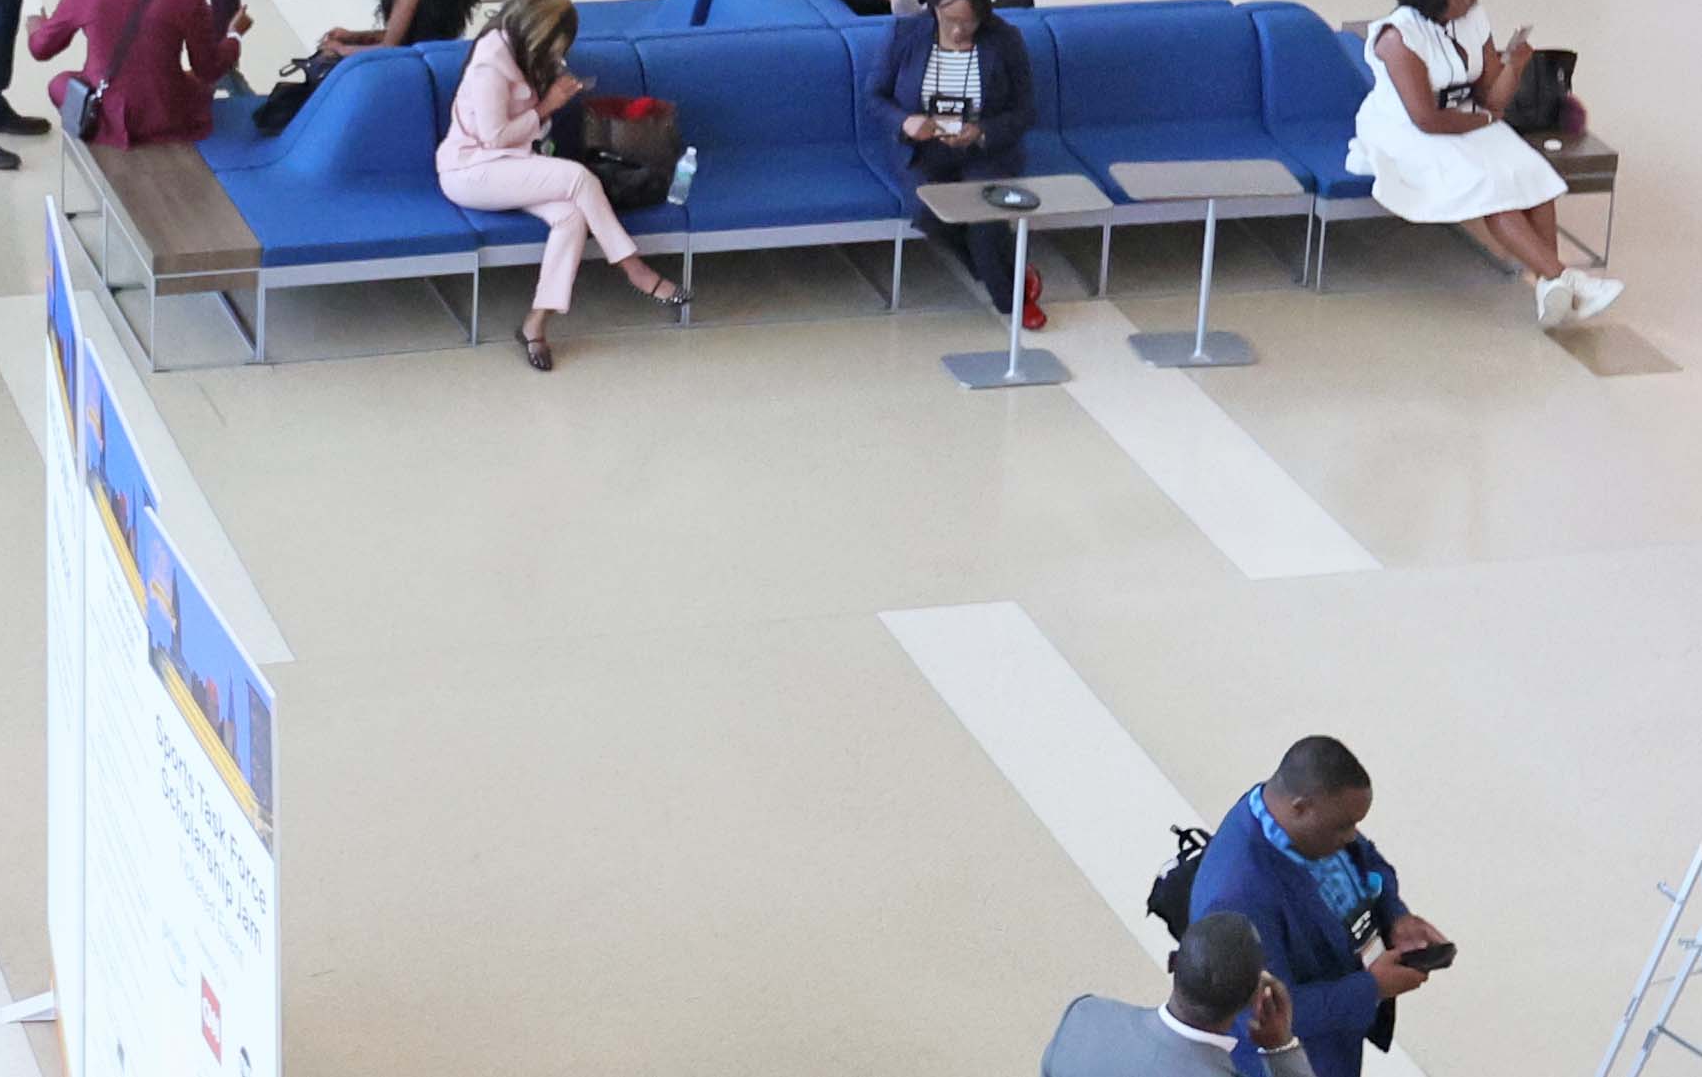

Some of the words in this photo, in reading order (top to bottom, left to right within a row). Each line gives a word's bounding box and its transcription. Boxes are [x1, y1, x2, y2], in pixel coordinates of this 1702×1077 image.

[155, 713, 195, 799] Sports
[197, 781, 226, 846] Task
[230, 832, 266, 915] Force
[161, 766, 233, 908] Scholarship
[237, 891, 262, 955] Jam
